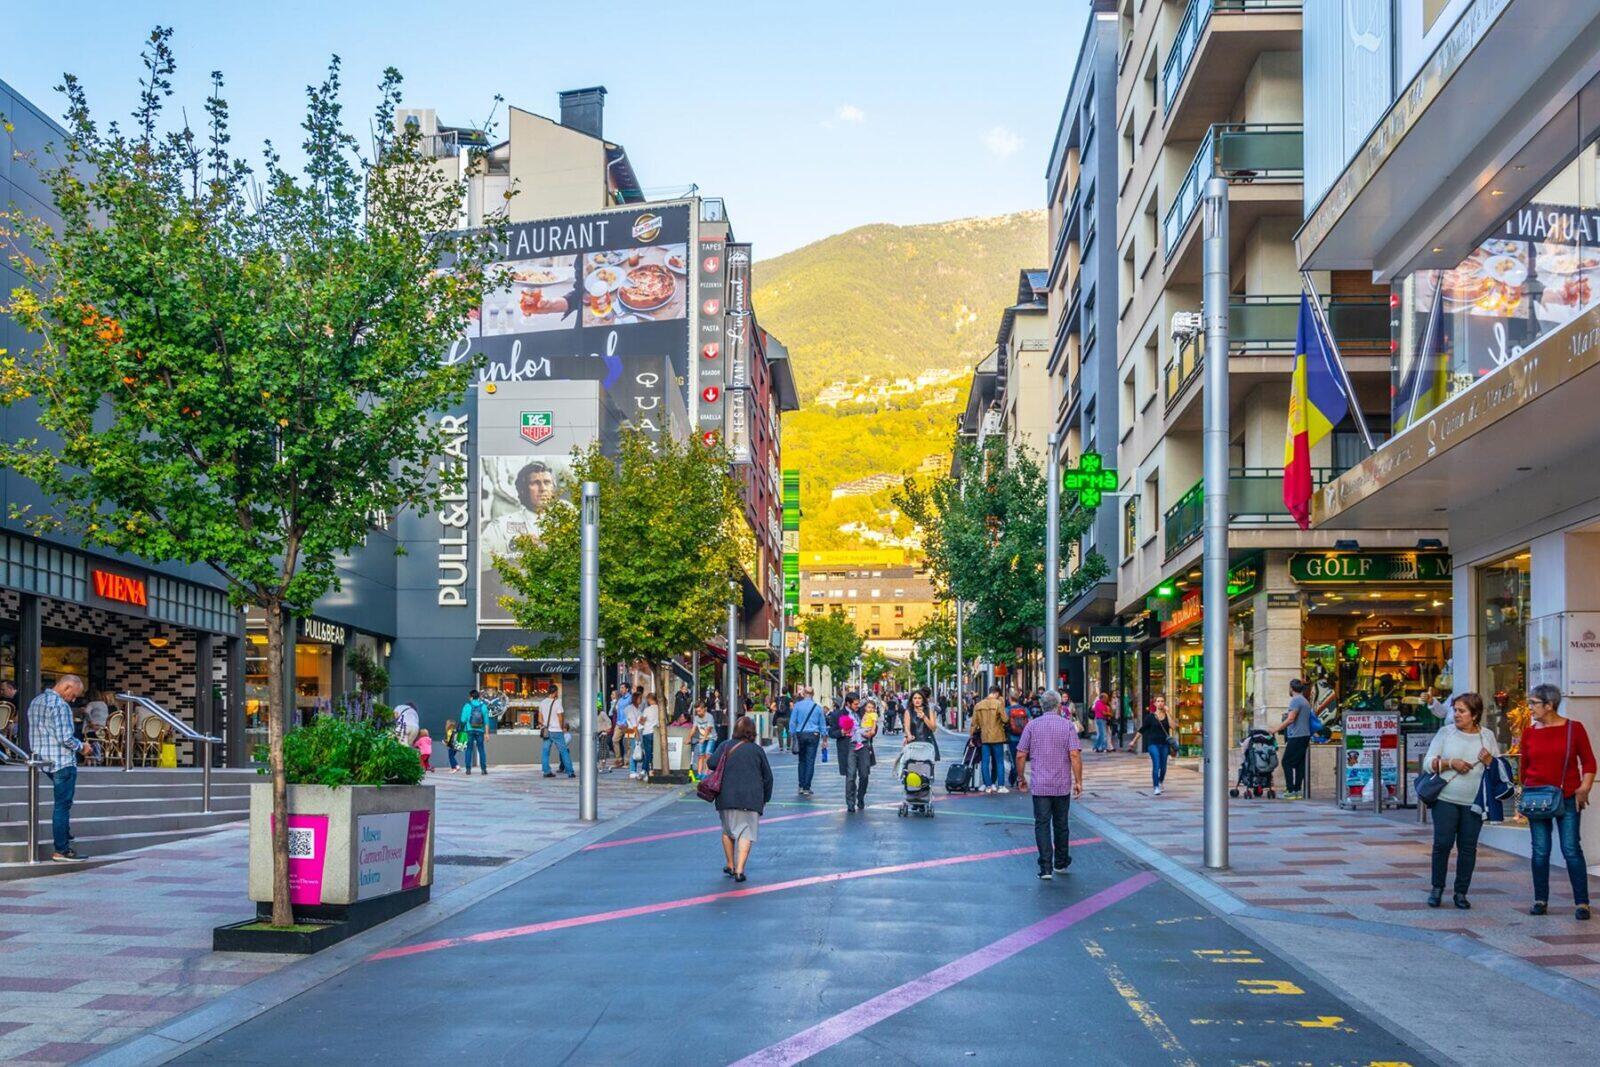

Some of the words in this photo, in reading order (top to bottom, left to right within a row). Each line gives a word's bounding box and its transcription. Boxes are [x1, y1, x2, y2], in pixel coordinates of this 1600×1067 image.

[702, 243, 721, 251] TAPES
[733, 359, 745, 433] RESTAURANT
[527, 414, 547, 426] TAG
[522, 427, 551, 440] HEUER
[438, 413, 469, 607] PULL&BEAR
[1306, 557, 1372, 577] GOLF
[91, 570, 147, 607] VIENA
[305, 618, 345, 645] PULL&BEAR
[1092, 635, 1122, 643] LOTTUSSE
[478, 662, 512, 673] Cartier
[540, 662, 574, 673] Cartier
